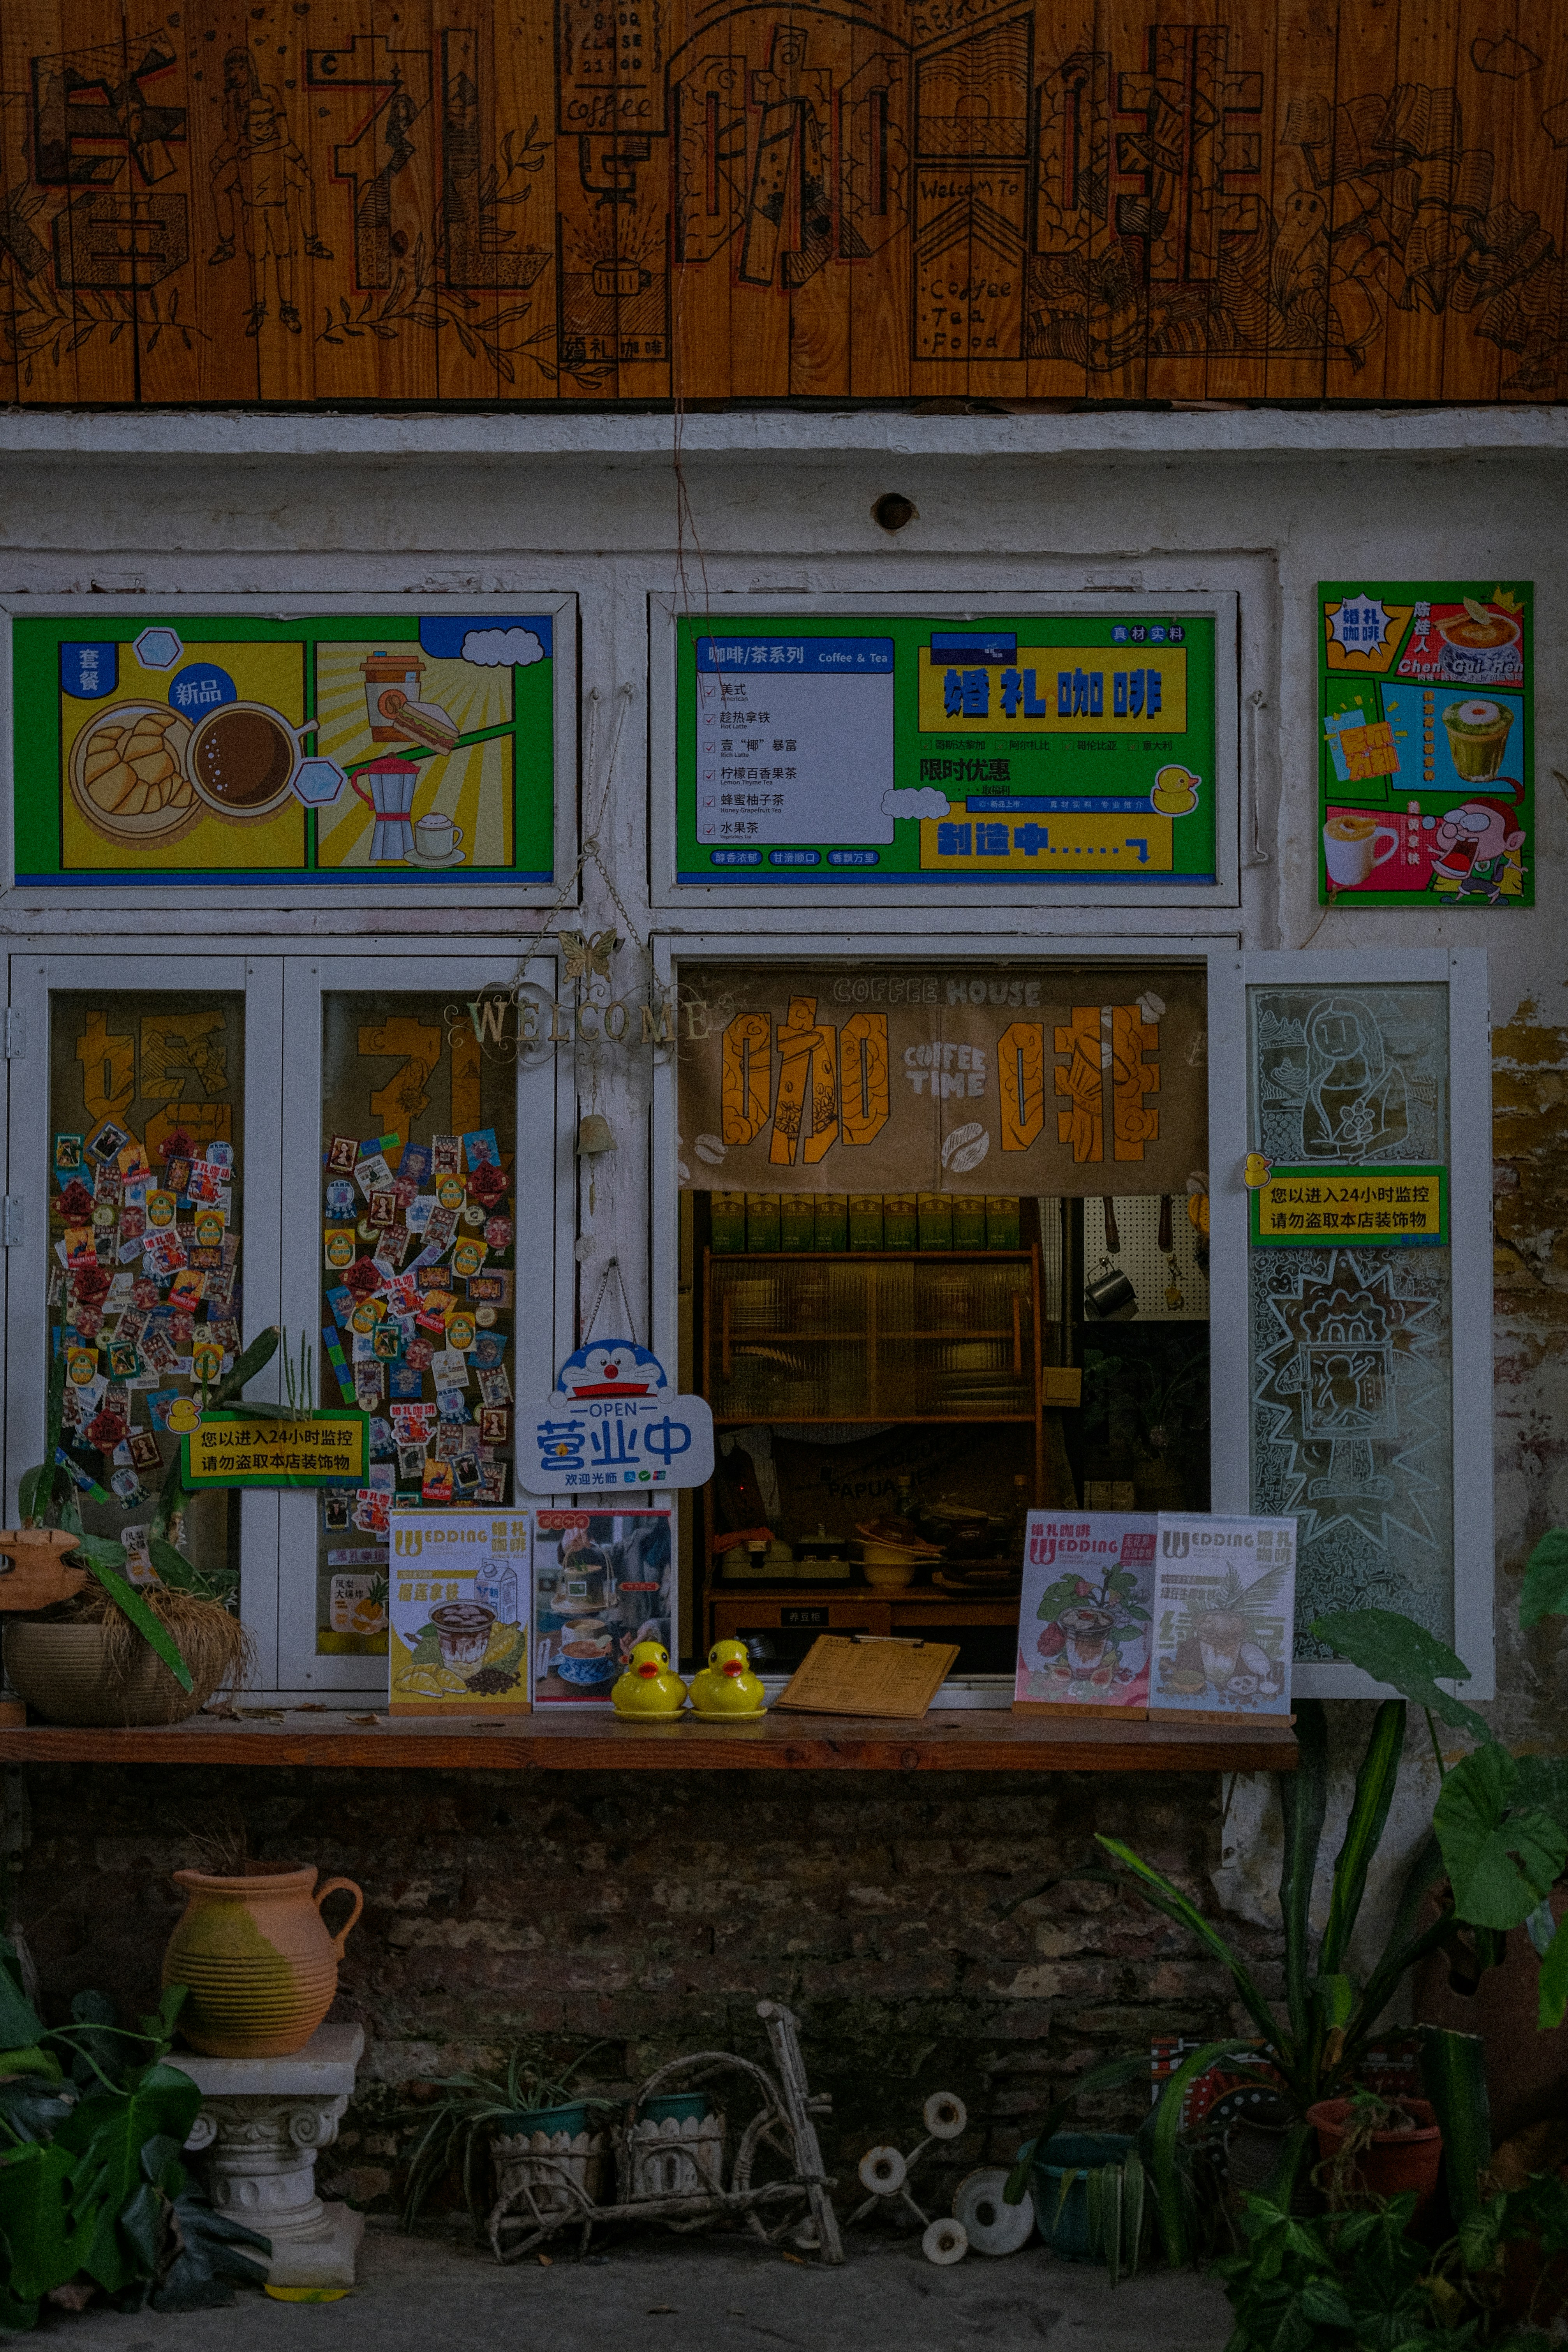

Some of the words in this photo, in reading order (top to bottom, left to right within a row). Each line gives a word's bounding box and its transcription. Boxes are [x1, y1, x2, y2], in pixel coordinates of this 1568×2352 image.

[1113, 627, 1184, 641] 真材实料
[1343, 626, 1379, 641] 咖啡
[708, 646, 805, 665] 咖啡/茶系列
[819, 653, 853, 663] Coffee
[857, 654, 866, 663] &
[870, 653, 888, 663] Tea
[79, 648, 100, 692] 套餐
[1398, 659, 1441, 673] Chen
[175, 678, 222, 706] 新品
[721, 683, 746, 696] 美式
[943, 667, 1162, 720] 婚礼咖啡
[720, 711, 771, 724] 趁热拿铁
[1077, 740, 1117, 751] 哥伦比亚
[1142, 740, 1173, 751] 意大利
[721, 767, 797, 780] 柠檬百香果茶
[919, 758, 1011, 782] 限时优惠
[721, 793, 784, 806] 蜂蜜柚子茶
[721, 821, 759, 834] 水果茶
[715, 853, 758, 863] 醇香浓郁
[773, 853, 816, 863] 甘滑顺口
[832, 853, 875, 863] 香飘万里
[833, 976, 938, 1004] COFFEE
[947, 980, 1042, 1007] HOUSE
[467, 1001, 710, 1043] WELCOME
[906, 1070, 987, 1099] TIME
[1270, 1186, 1430, 1204] 您以进入24小时监控
[1270, 1212, 1427, 1229] 请勿盗取本店装饰物
[589, 1402, 637, 1417] OPEN
[201, 1429, 353, 1448] 您以进入24小时监控
[537, 1415, 692, 1471] 营业中
[201, 1453, 350, 1472] 请勿盗取本店装饰物
[565, 1472, 618, 1487] 欢迎光临
[828, 1478, 897, 1499] PAPUA
[395, 1529, 488, 1557] WEDDING
[1029, 1538, 1118, 1565] WEDDING
